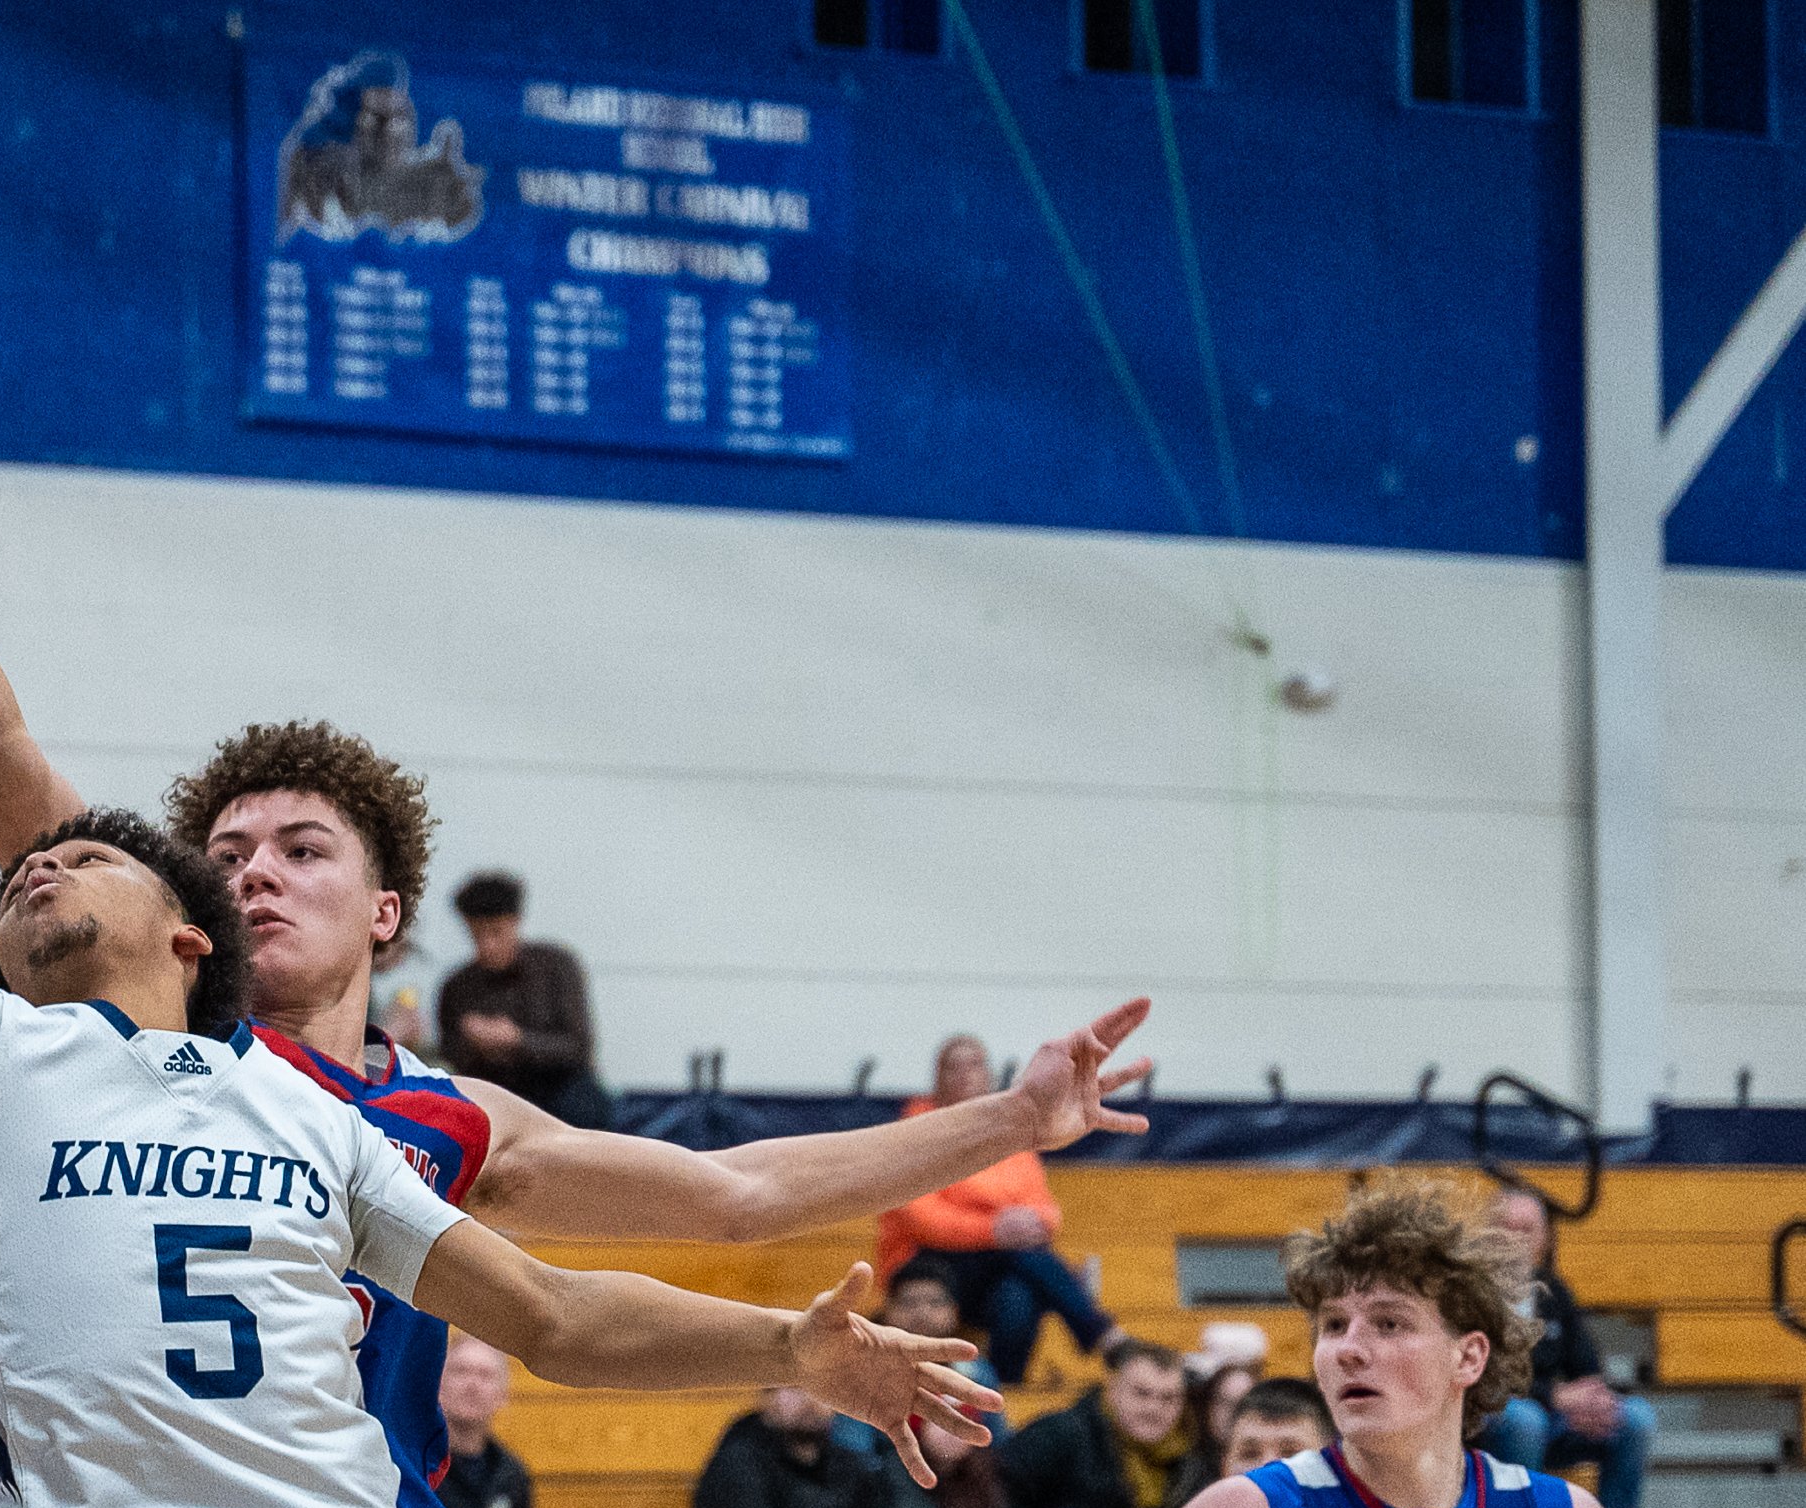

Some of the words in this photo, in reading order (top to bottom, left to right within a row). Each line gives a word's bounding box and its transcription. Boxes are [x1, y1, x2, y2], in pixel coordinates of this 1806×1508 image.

[163, 1060, 213, 1076] adidas
[39, 1140, 330, 1219] KNIGHTS
[154, 1224, 264, 1399] 5
